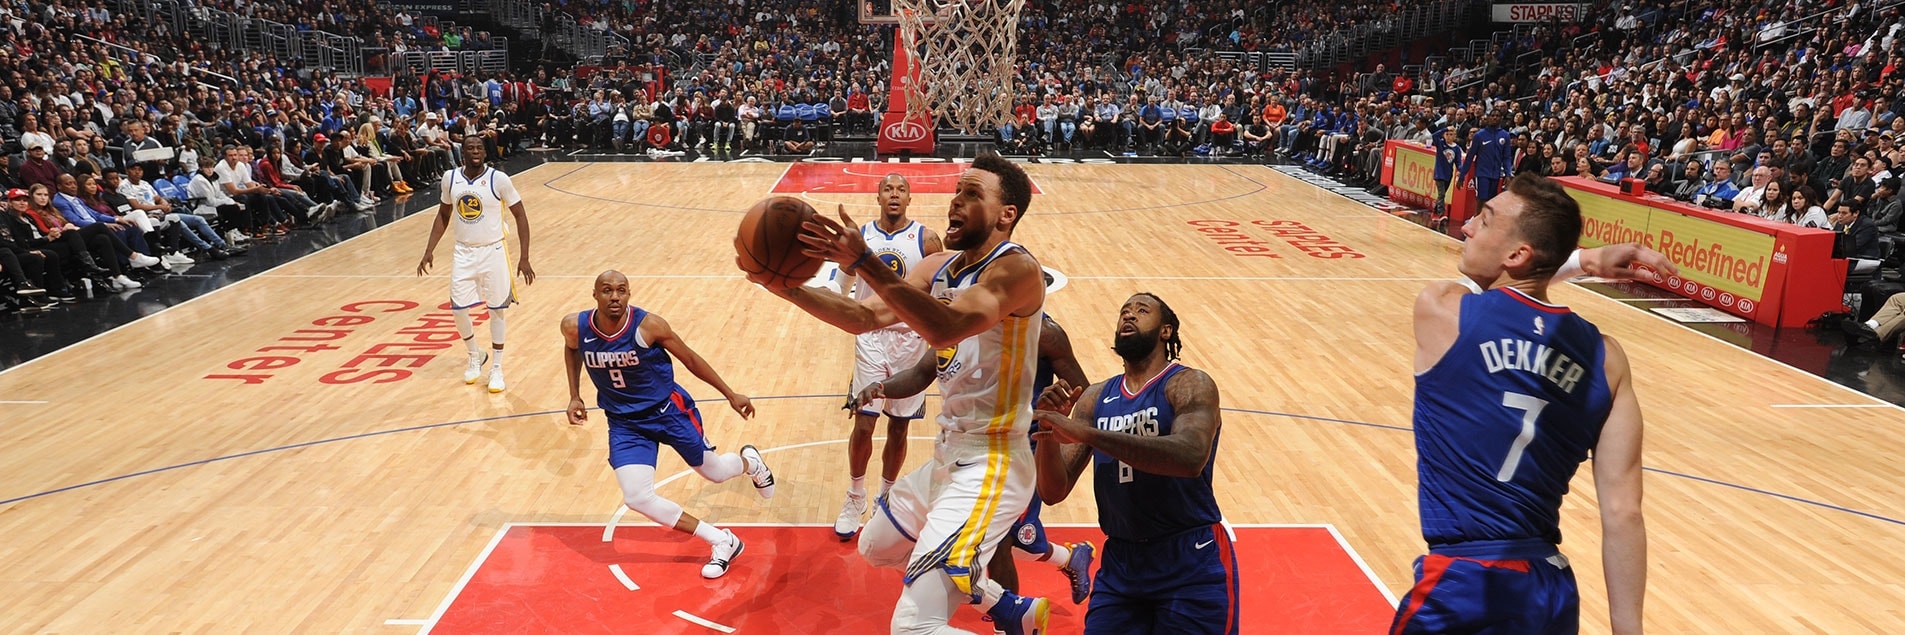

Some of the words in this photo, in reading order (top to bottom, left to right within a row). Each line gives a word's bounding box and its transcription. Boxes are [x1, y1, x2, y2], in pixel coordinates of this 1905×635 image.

[891, 126, 919, 138] KIA
[1402, 153, 1437, 197] Long
[467, 198, 479, 207] 23
[1186, 219, 1283, 259] Center
[1250, 219, 1366, 259] STAPLES
[1658, 229, 1764, 288] Redefined
[202, 300, 419, 385] Center
[584, 350, 640, 369] CLIPPERS
[608, 369, 627, 389] 9
[1479, 338, 1585, 394] DEKKER
[1096, 406, 1160, 437] CLIPPERS
[1496, 391, 1550, 482] 7
